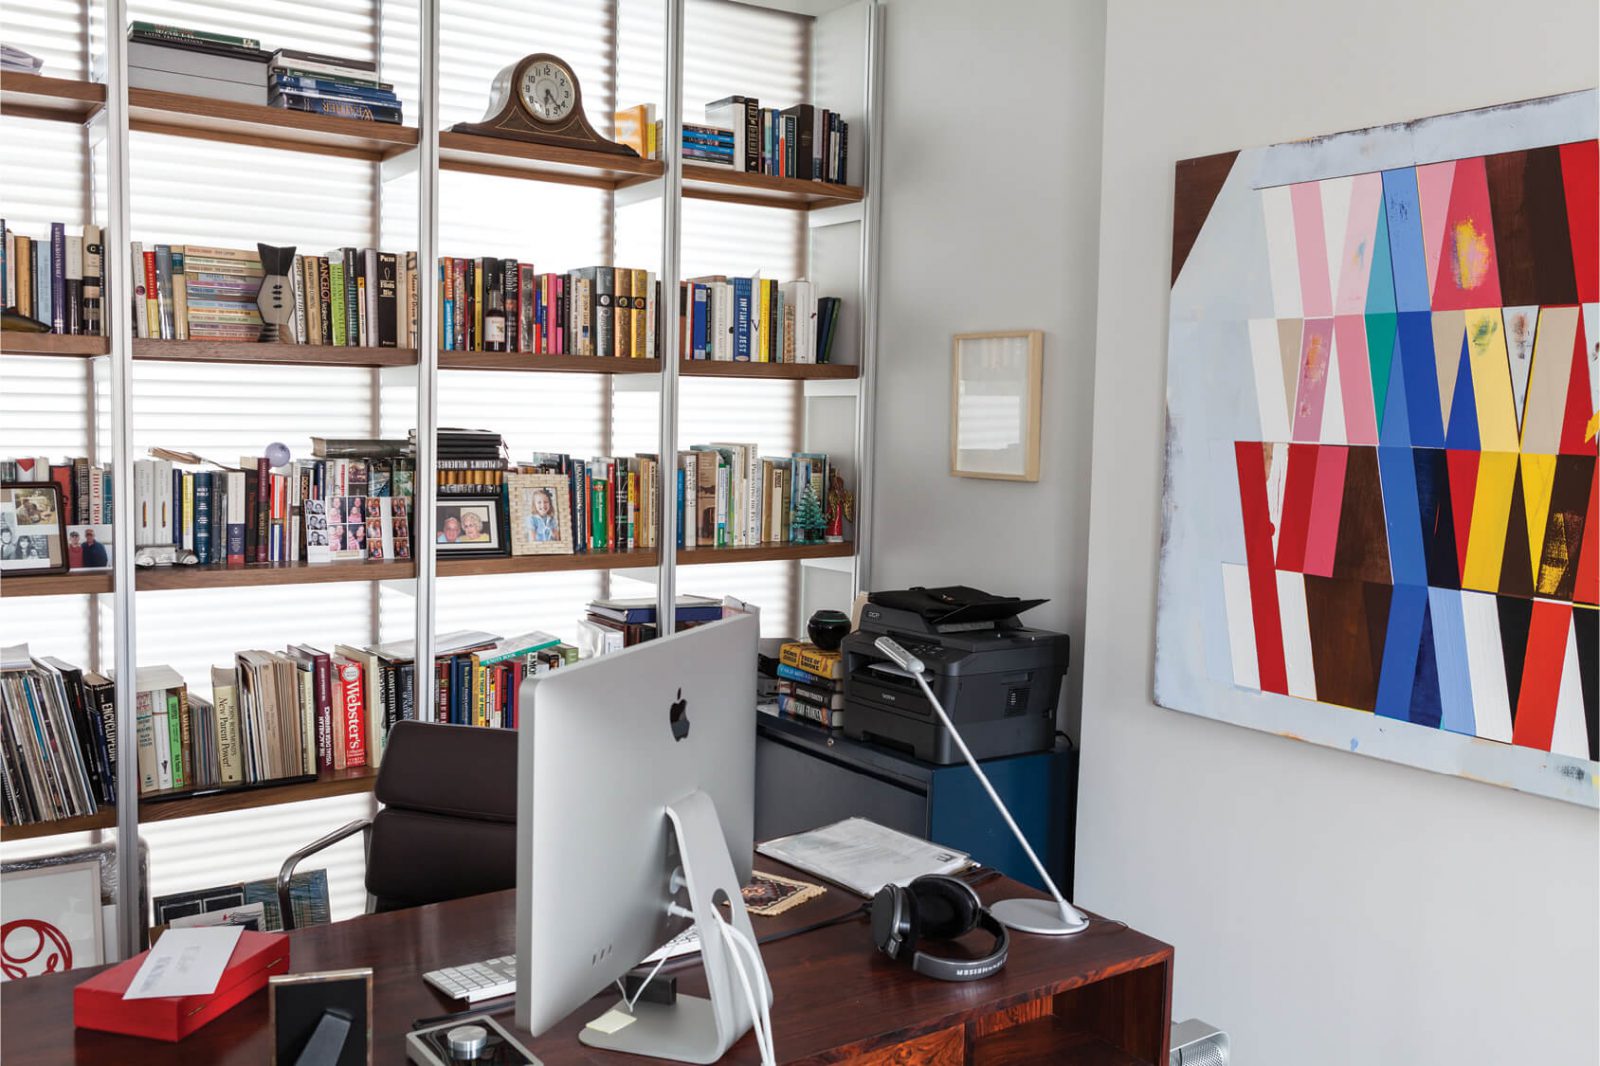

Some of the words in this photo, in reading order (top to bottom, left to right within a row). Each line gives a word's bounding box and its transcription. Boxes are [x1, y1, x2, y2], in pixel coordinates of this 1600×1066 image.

[319, 258, 330, 304] LANCELOT
[739, 298, 747, 332] INFINITE
[219, 697, 227, 715] New
[347, 681, 361, 748] Webster's
[102, 703, 116, 762] ENCYCLOPEDIA
[220, 717, 229, 741] Parent
[222, 744, 231, 768] Power!
